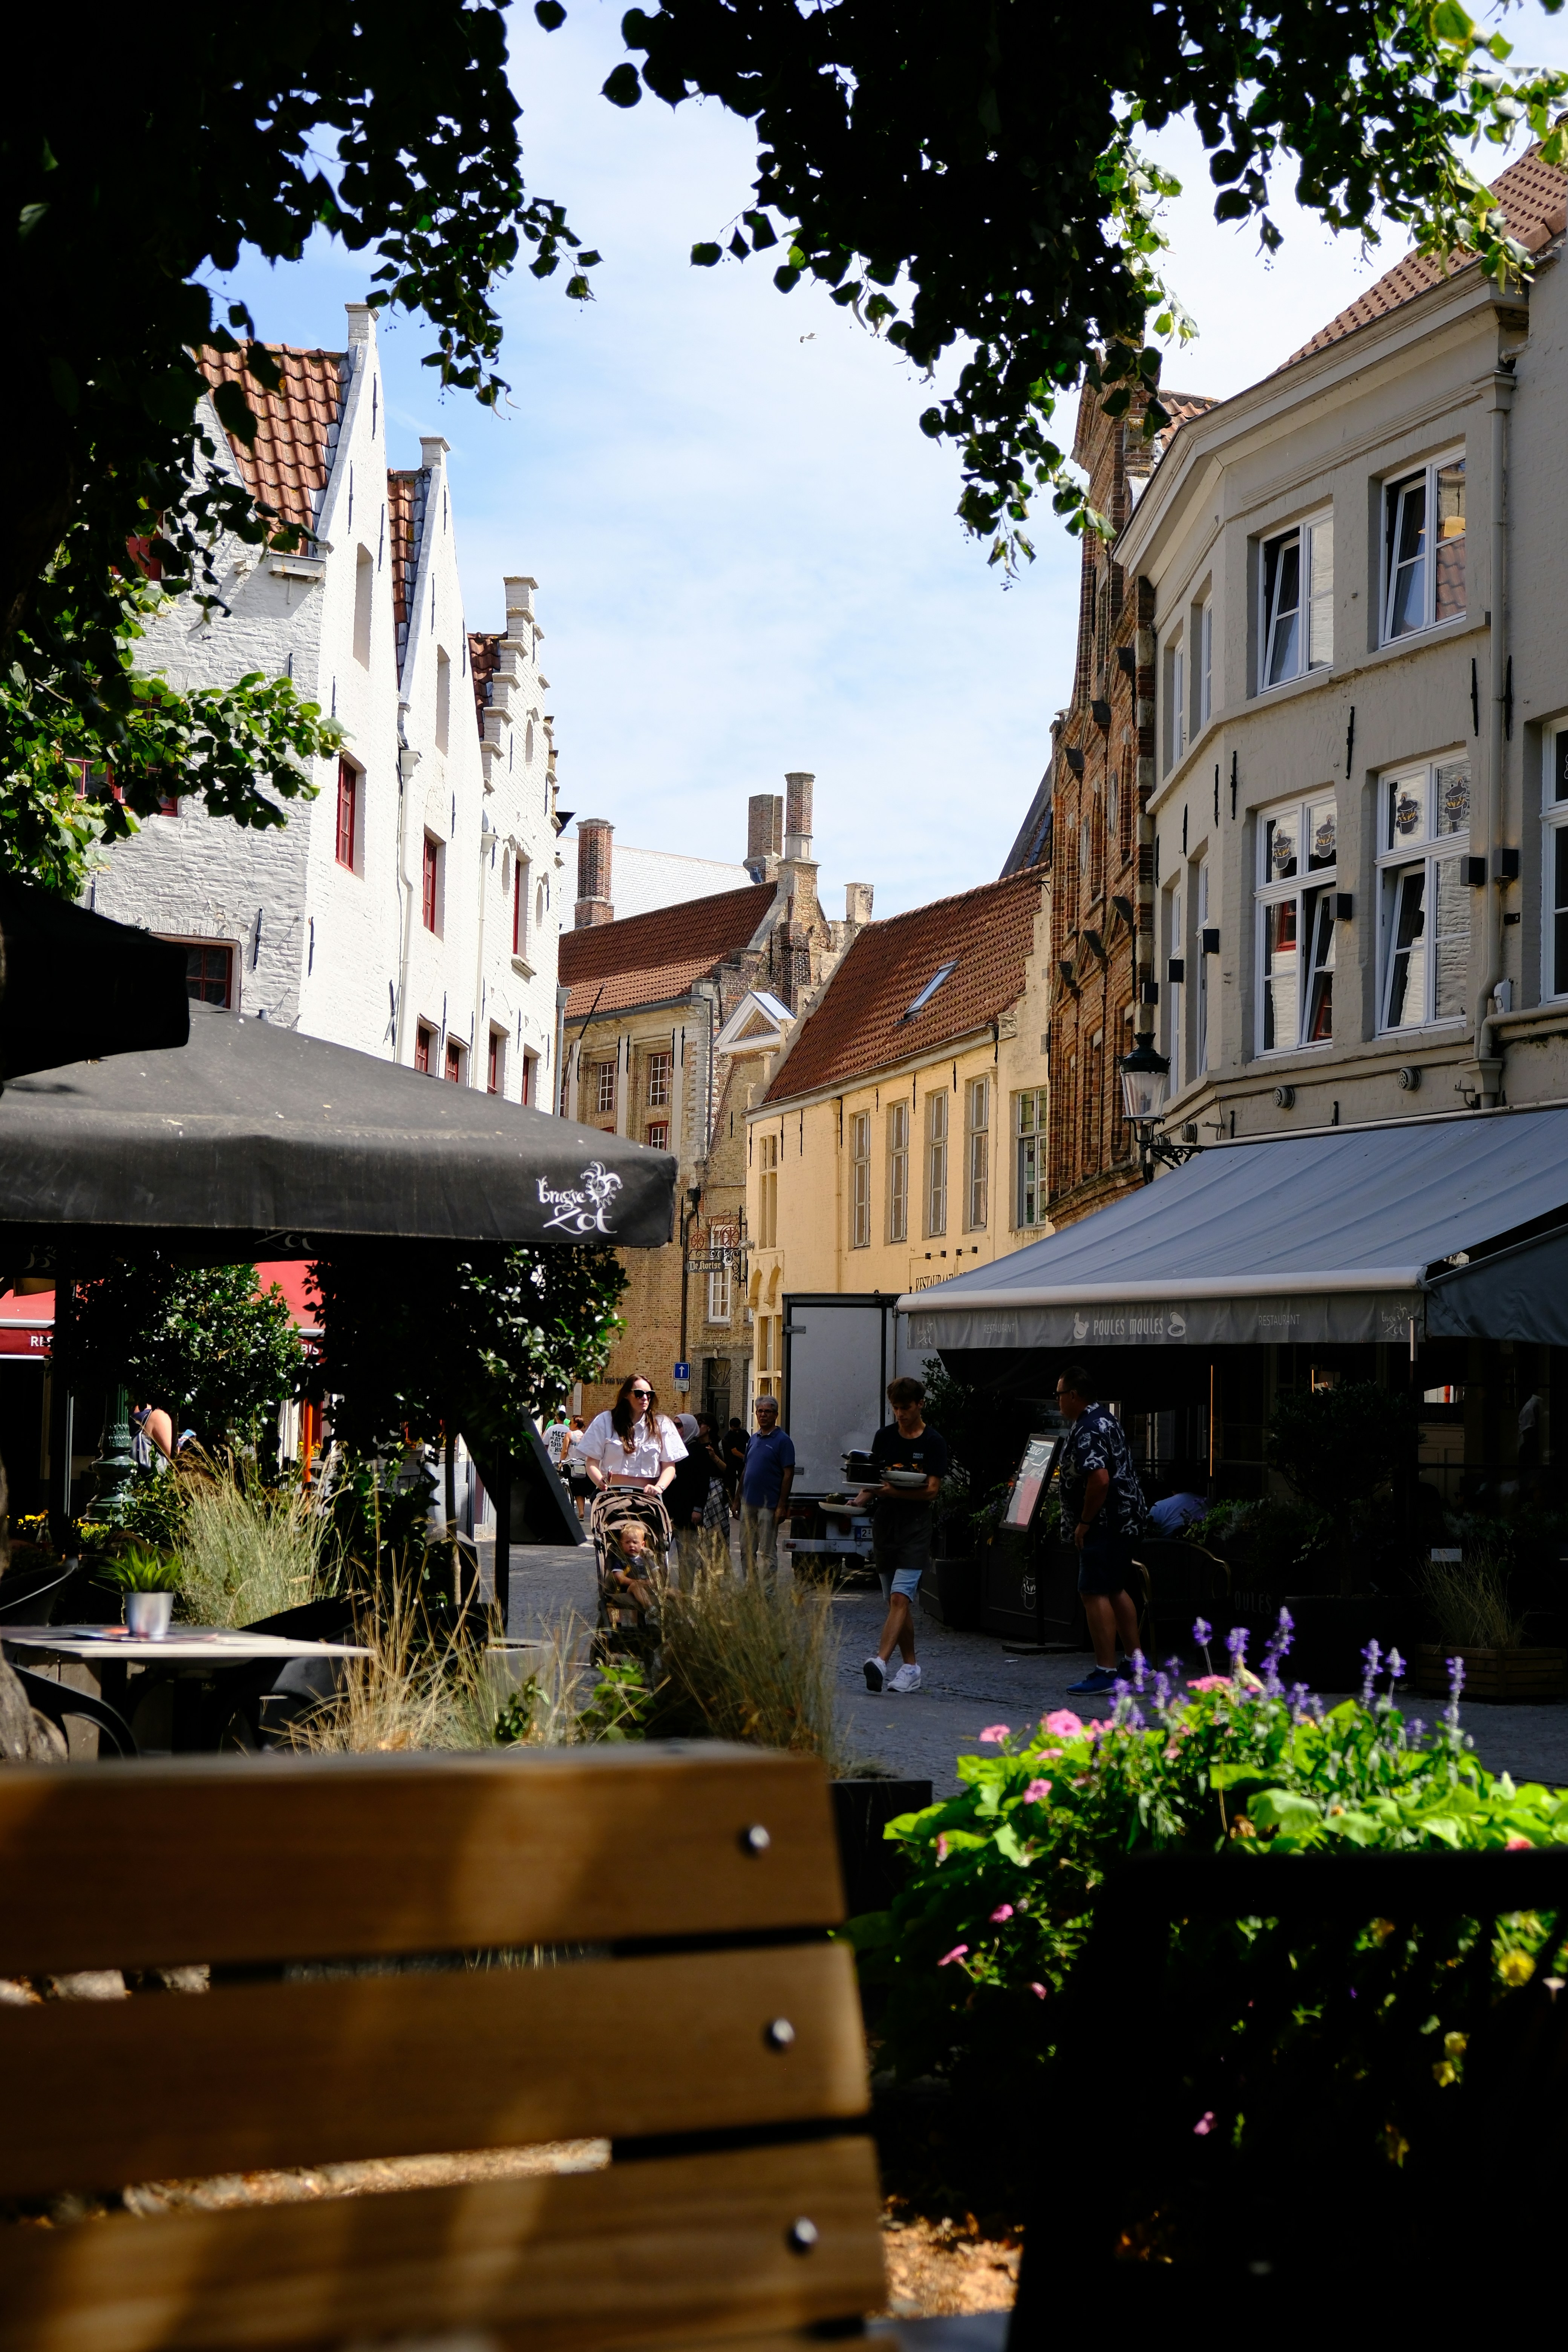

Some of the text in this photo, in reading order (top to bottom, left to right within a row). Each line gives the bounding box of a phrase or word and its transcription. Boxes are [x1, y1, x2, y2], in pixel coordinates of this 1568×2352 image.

[543, 1205, 617, 1234] Zot
[689, 1260, 721, 1272] De Koetse
[983, 1314, 1300, 1335] RESTAURANT POULES MOULES RESTAURANT
